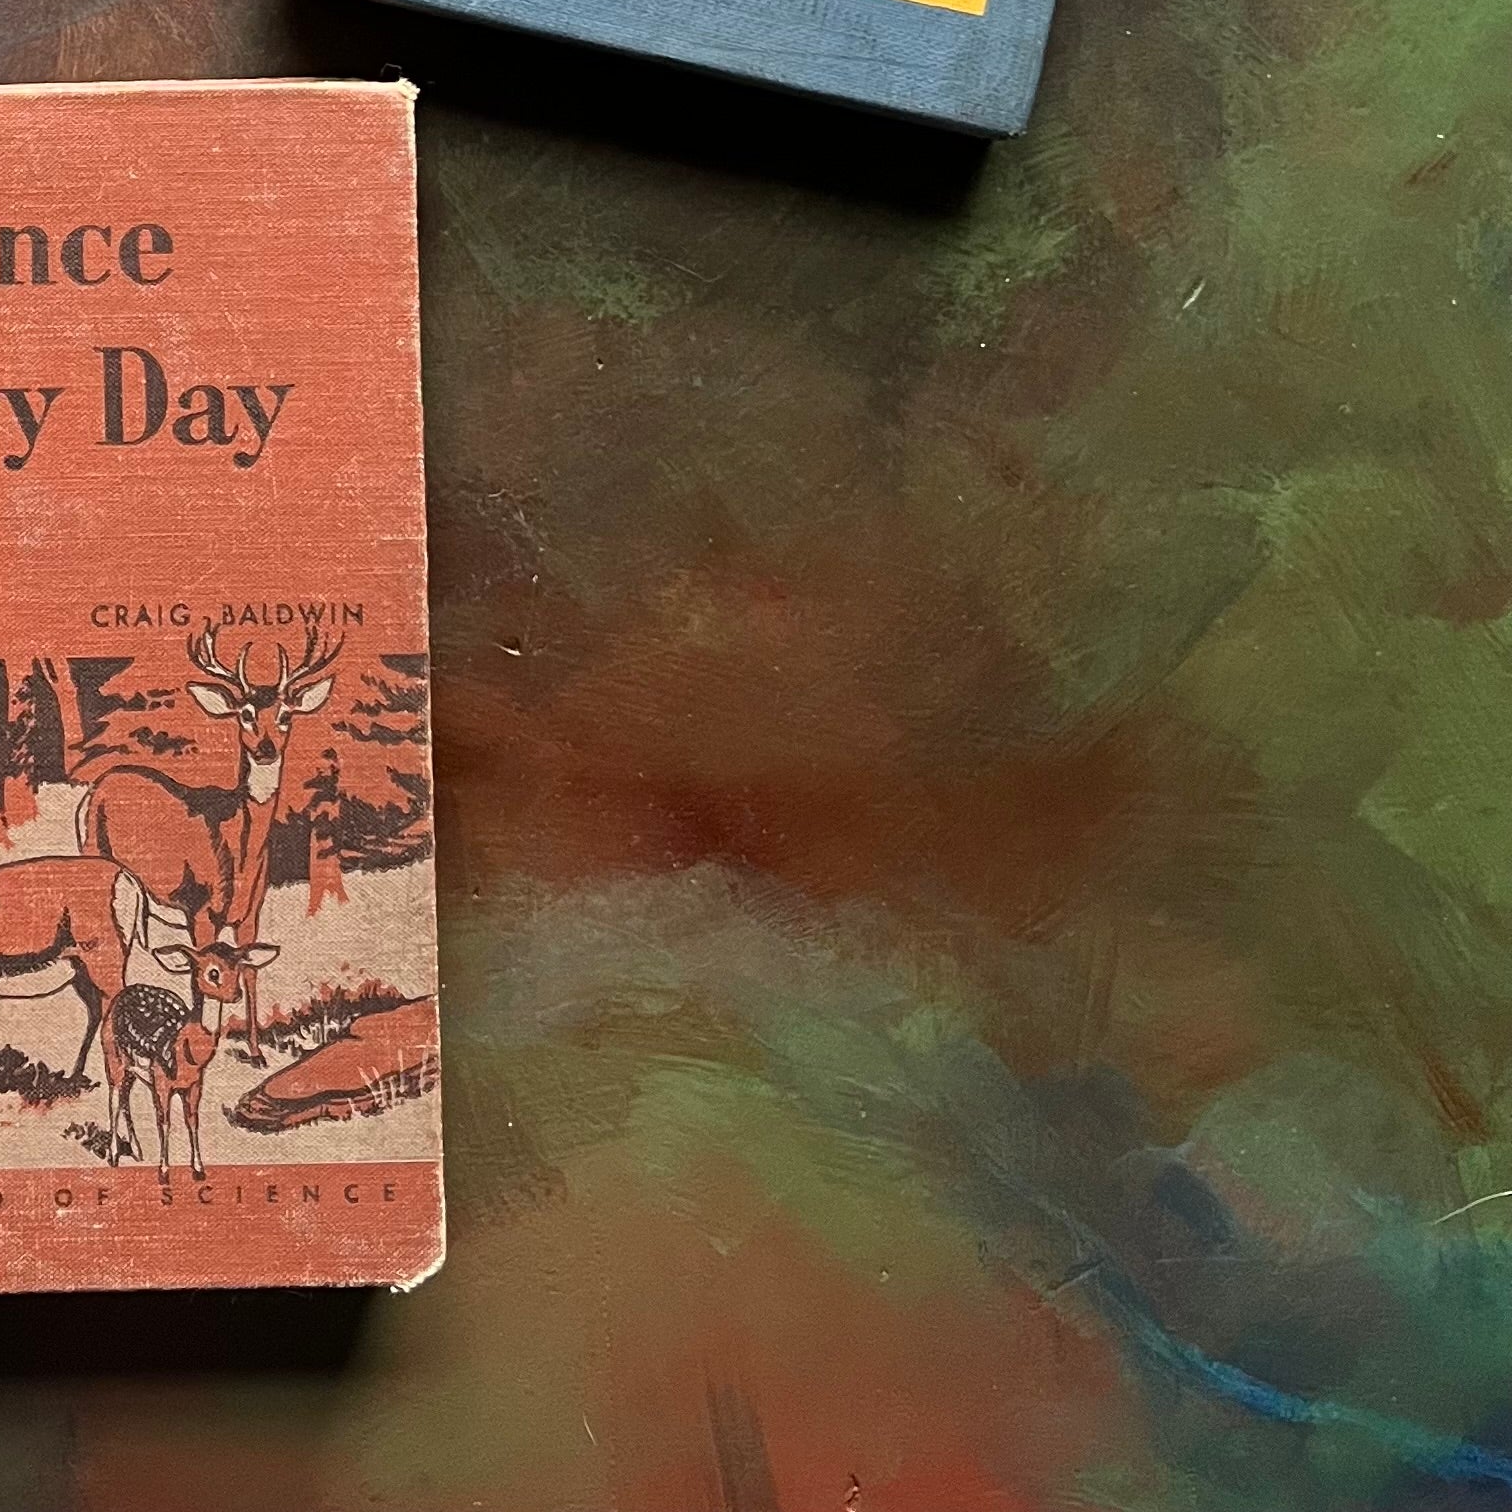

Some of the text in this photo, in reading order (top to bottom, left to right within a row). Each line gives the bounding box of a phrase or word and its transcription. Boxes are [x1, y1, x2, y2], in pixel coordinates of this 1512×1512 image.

[94, 345, 295, 470] Day
[90, 603, 364, 628] CRAIG BALDWIN
[54, 1187, 110, 1209] OF
[159, 1183, 397, 1207] SCIENCE
